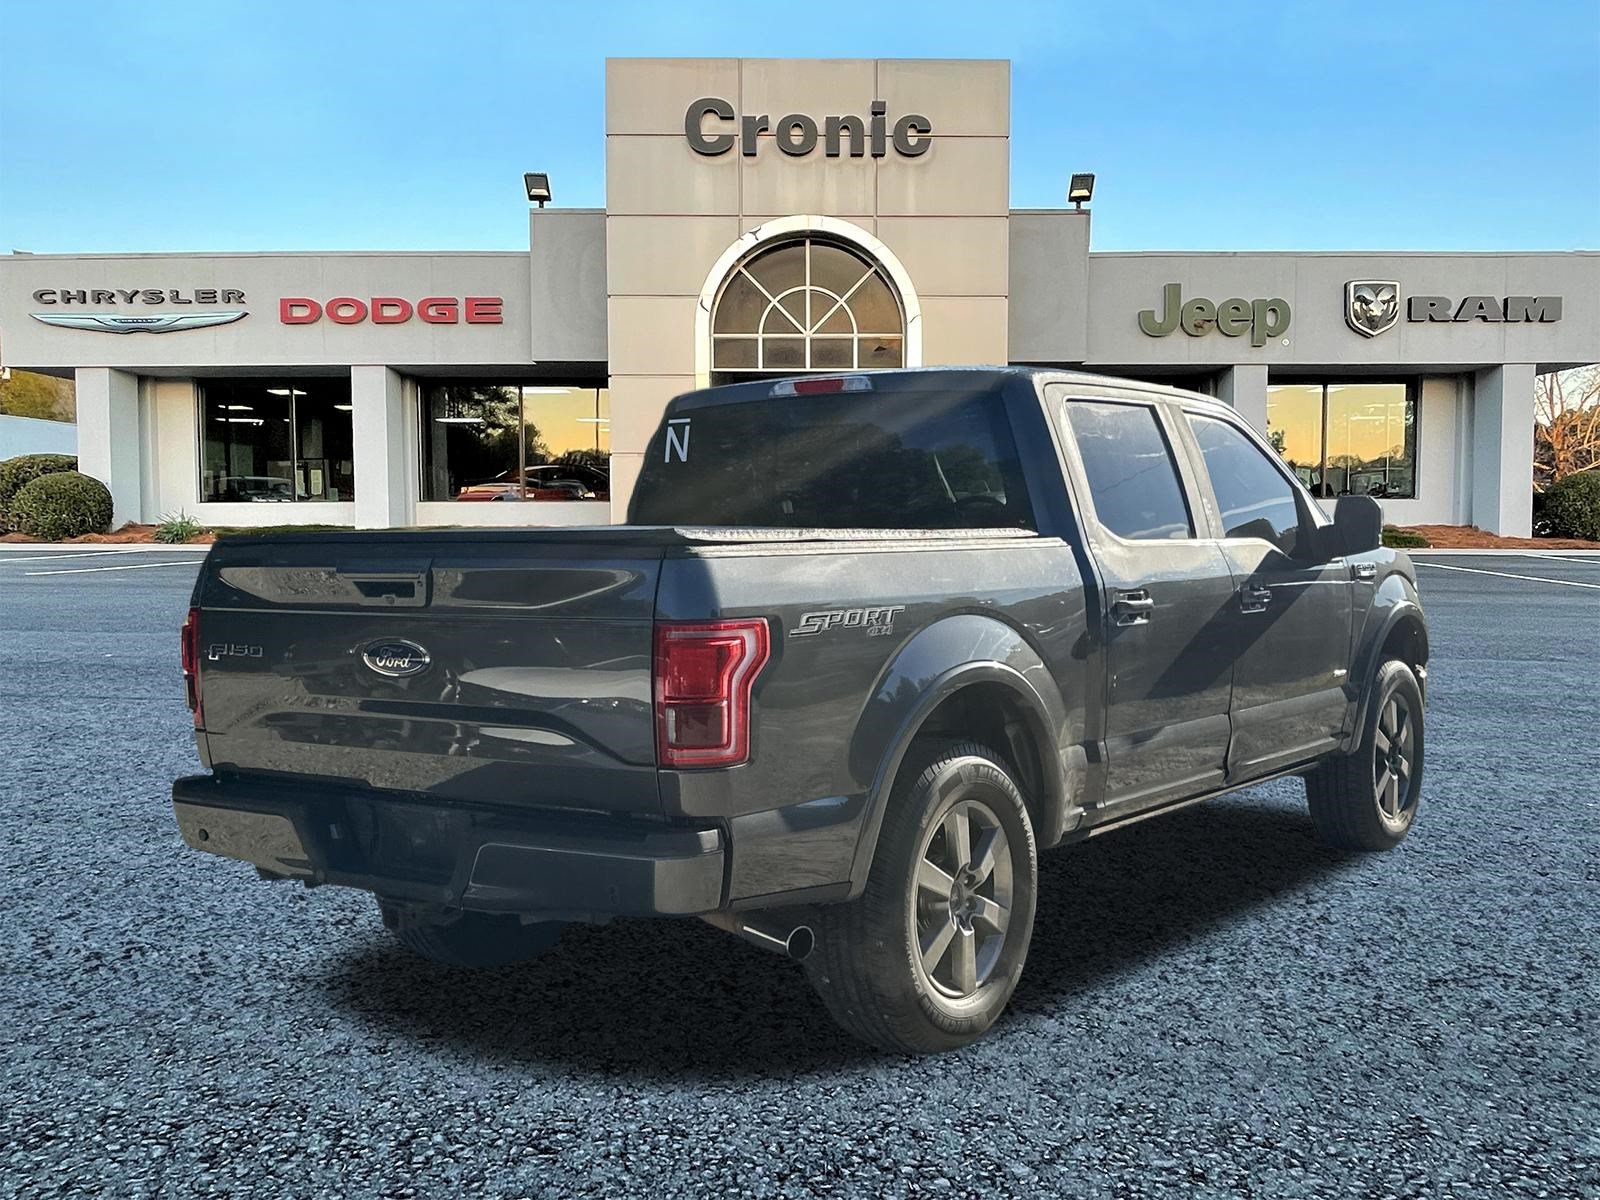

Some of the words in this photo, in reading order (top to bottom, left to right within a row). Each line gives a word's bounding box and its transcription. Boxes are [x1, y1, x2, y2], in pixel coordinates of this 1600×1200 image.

[685, 98, 932, 157] Cronic
[32, 288, 246, 304] CHRYSLER
[1408, 296, 1563, 323] RAM
[280, 297, 504, 325] DODGE
[1138, 283, 1291, 346] Jeep
[789, 605, 906, 637] SPORT
[376, 646, 412, 668] Ford
